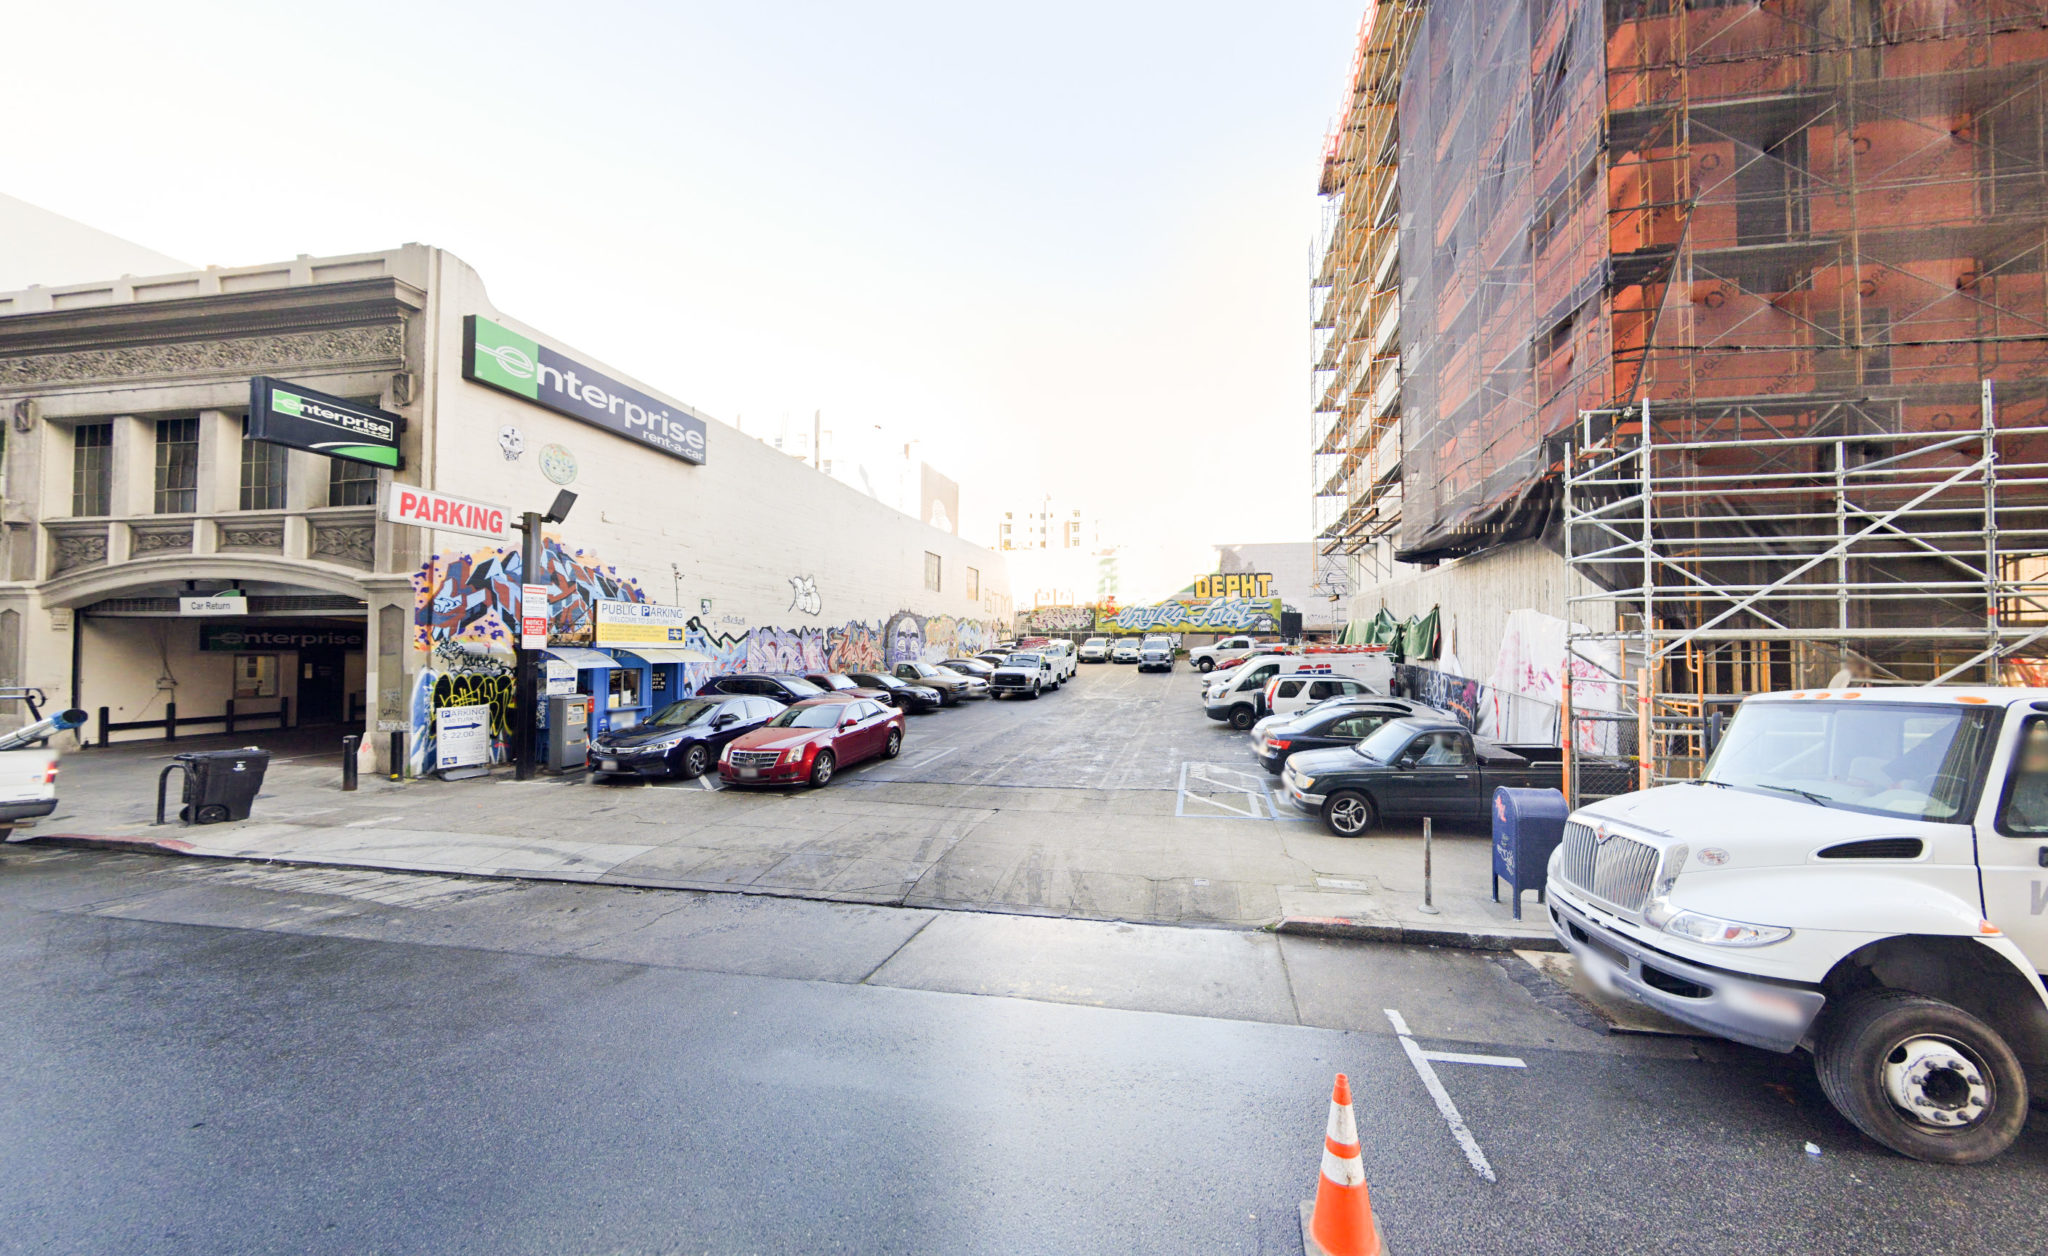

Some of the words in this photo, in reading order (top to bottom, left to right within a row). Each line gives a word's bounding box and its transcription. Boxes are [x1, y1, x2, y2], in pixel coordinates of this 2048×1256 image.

[476, 342, 704, 449] enterprise
[274, 398, 390, 434] enterprise
[352, 426, 389, 439] rent-a-car
[643, 430, 703, 460] rent-a-car
[400, 491, 503, 534] PARKING
[1194, 572, 1273, 598] DEPHT
[191, 601, 204, 610] Car
[205, 601, 231, 610] Return
[602, 603, 637, 616] PUBLIC
[641, 605, 683, 619] PARKING
[209, 632, 361, 647] enterprise
[441, 707, 485, 718] PARKING
[451, 730, 475, 739] 22.00
